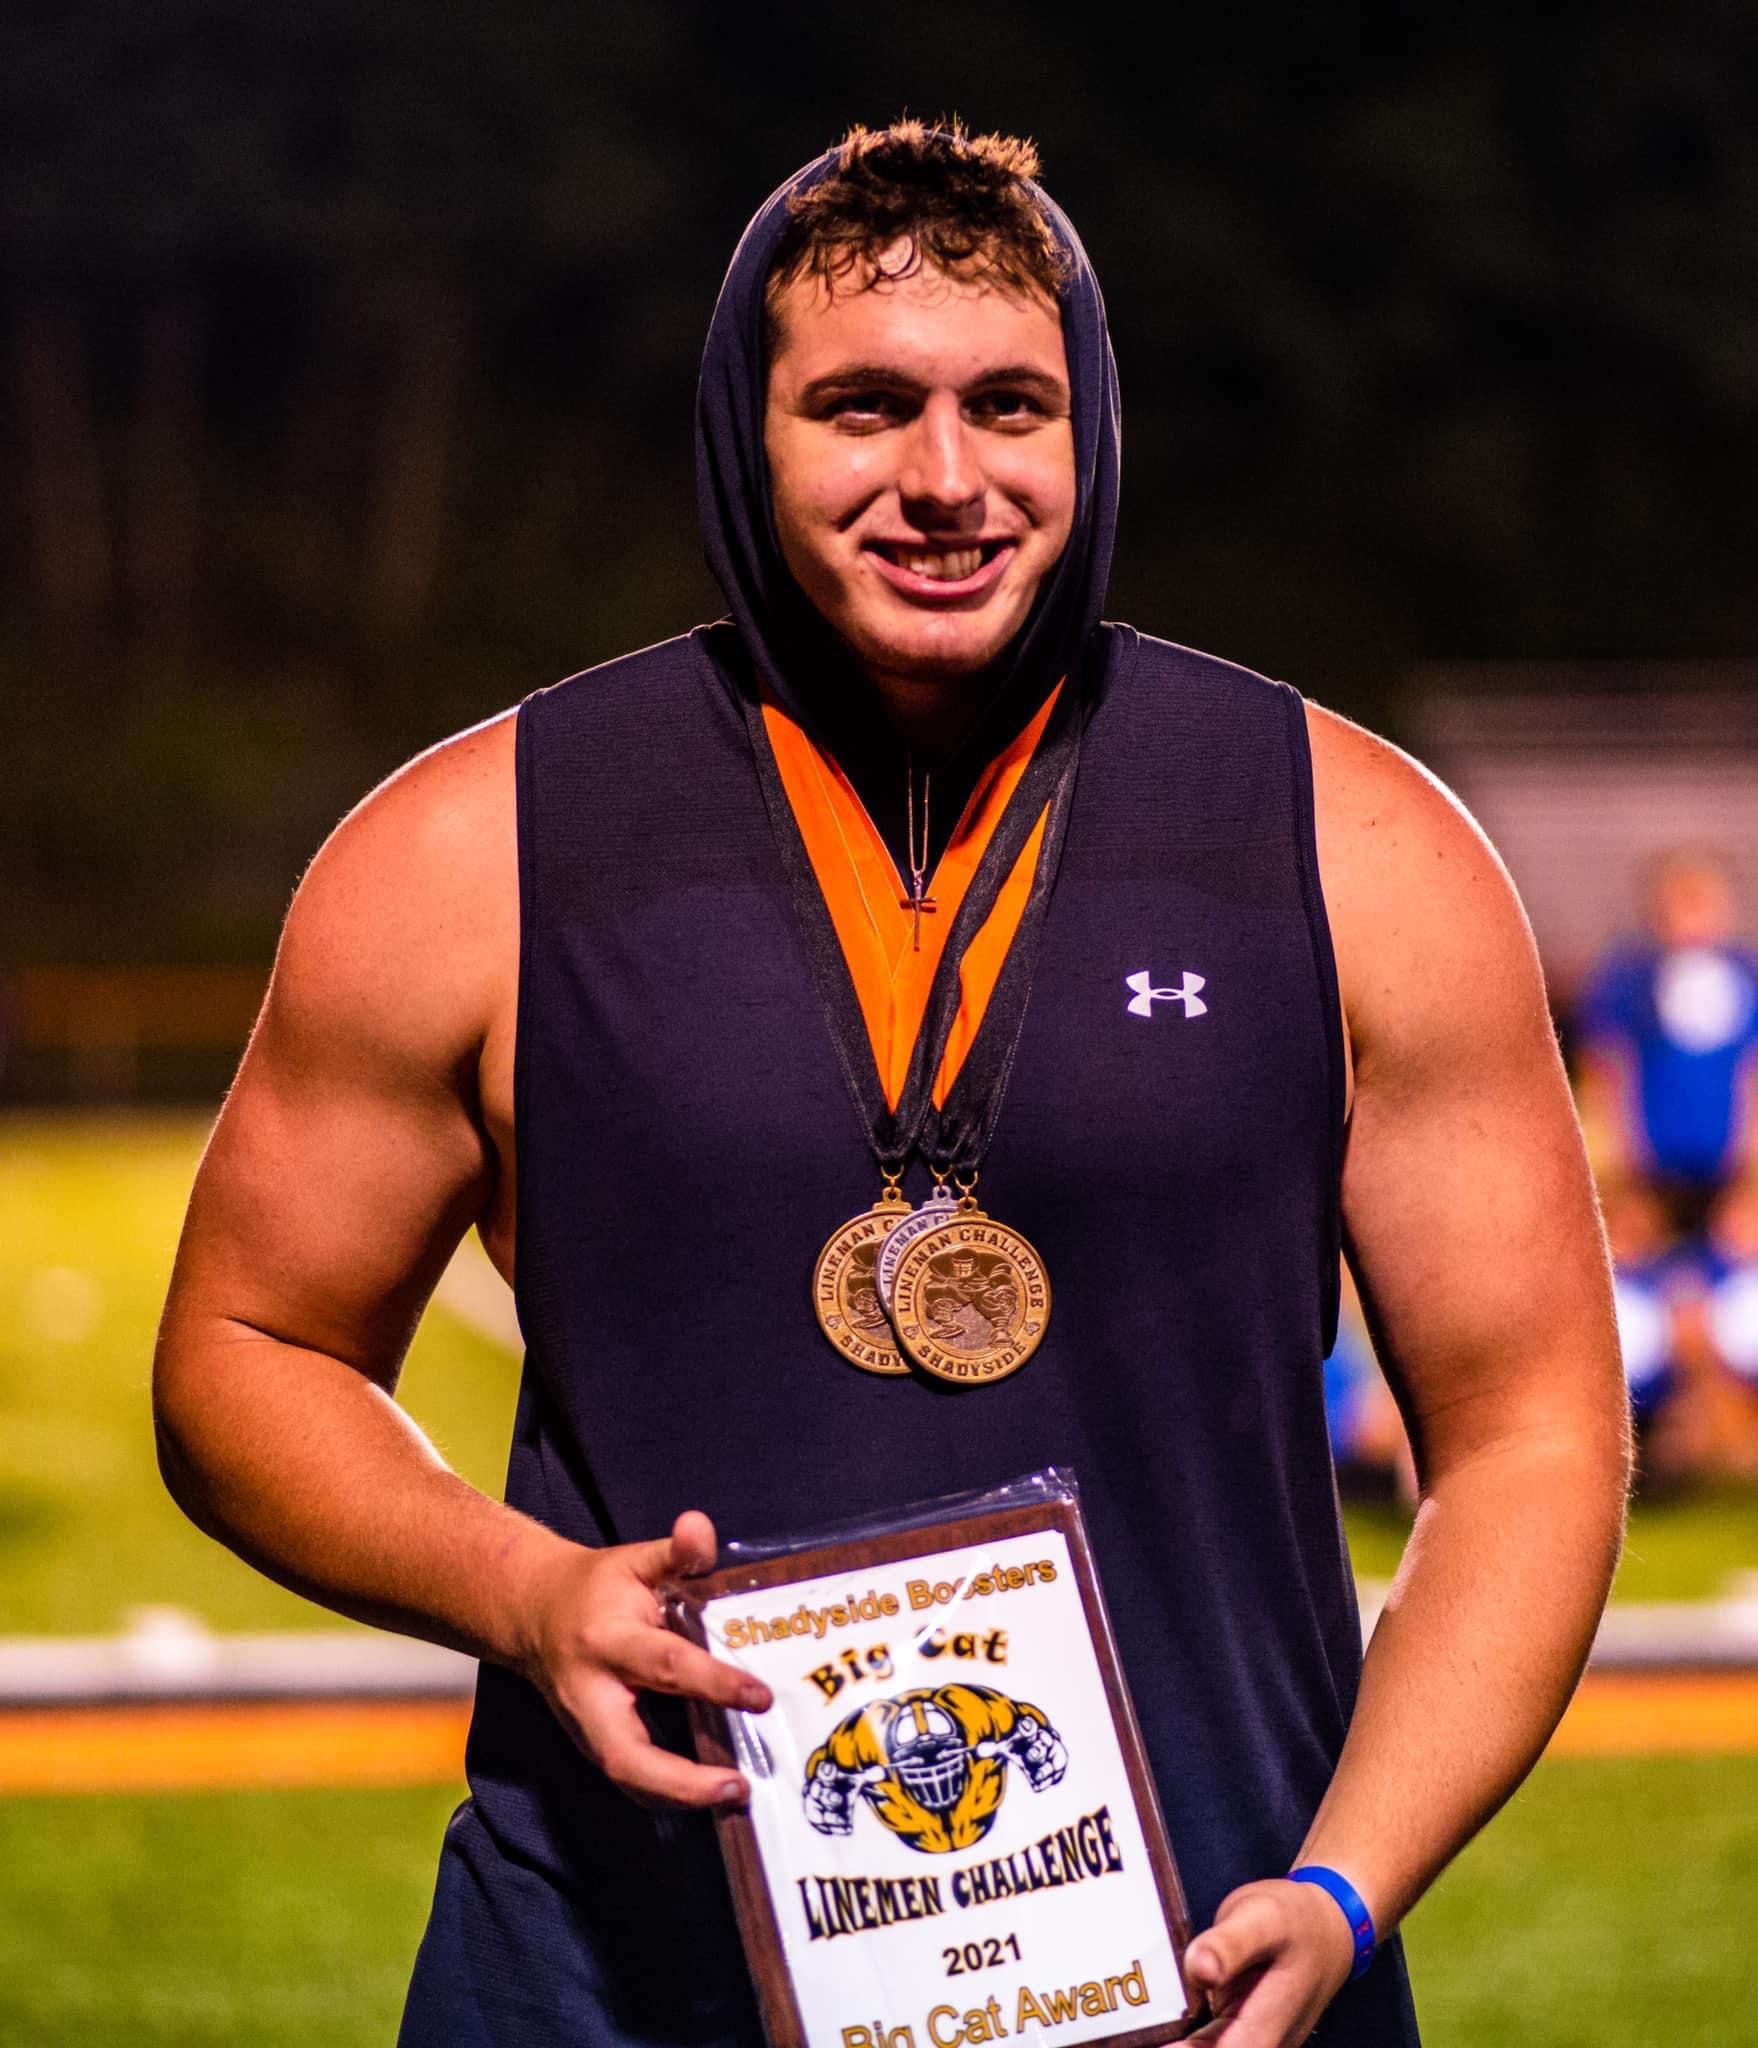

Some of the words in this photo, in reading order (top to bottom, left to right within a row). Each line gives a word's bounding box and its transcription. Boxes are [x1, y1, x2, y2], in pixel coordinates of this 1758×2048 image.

[820, 1222, 876, 1302] LINEMAN
[883, 1217, 929, 1285] LINEMAN
[898, 1233, 953, 1312] LINEMAN
[959, 1228, 1044, 1308] CHALLENGE
[840, 1334, 901, 1368] SHADY
[918, 1343, 1026, 1377] SHADYSIDE
[723, 1589, 899, 1649] Shadyside
[802, 1642, 895, 1706] Big
[914, 1624, 1008, 1666] Cat
[796, 1873, 946, 1941] LINEMEN
[951, 1804, 1125, 1909] CHALLENGE
[941, 1932, 1022, 1977] 2021
[927, 1994, 1008, 2048] Cat
[1015, 1959, 1150, 2034] Award
